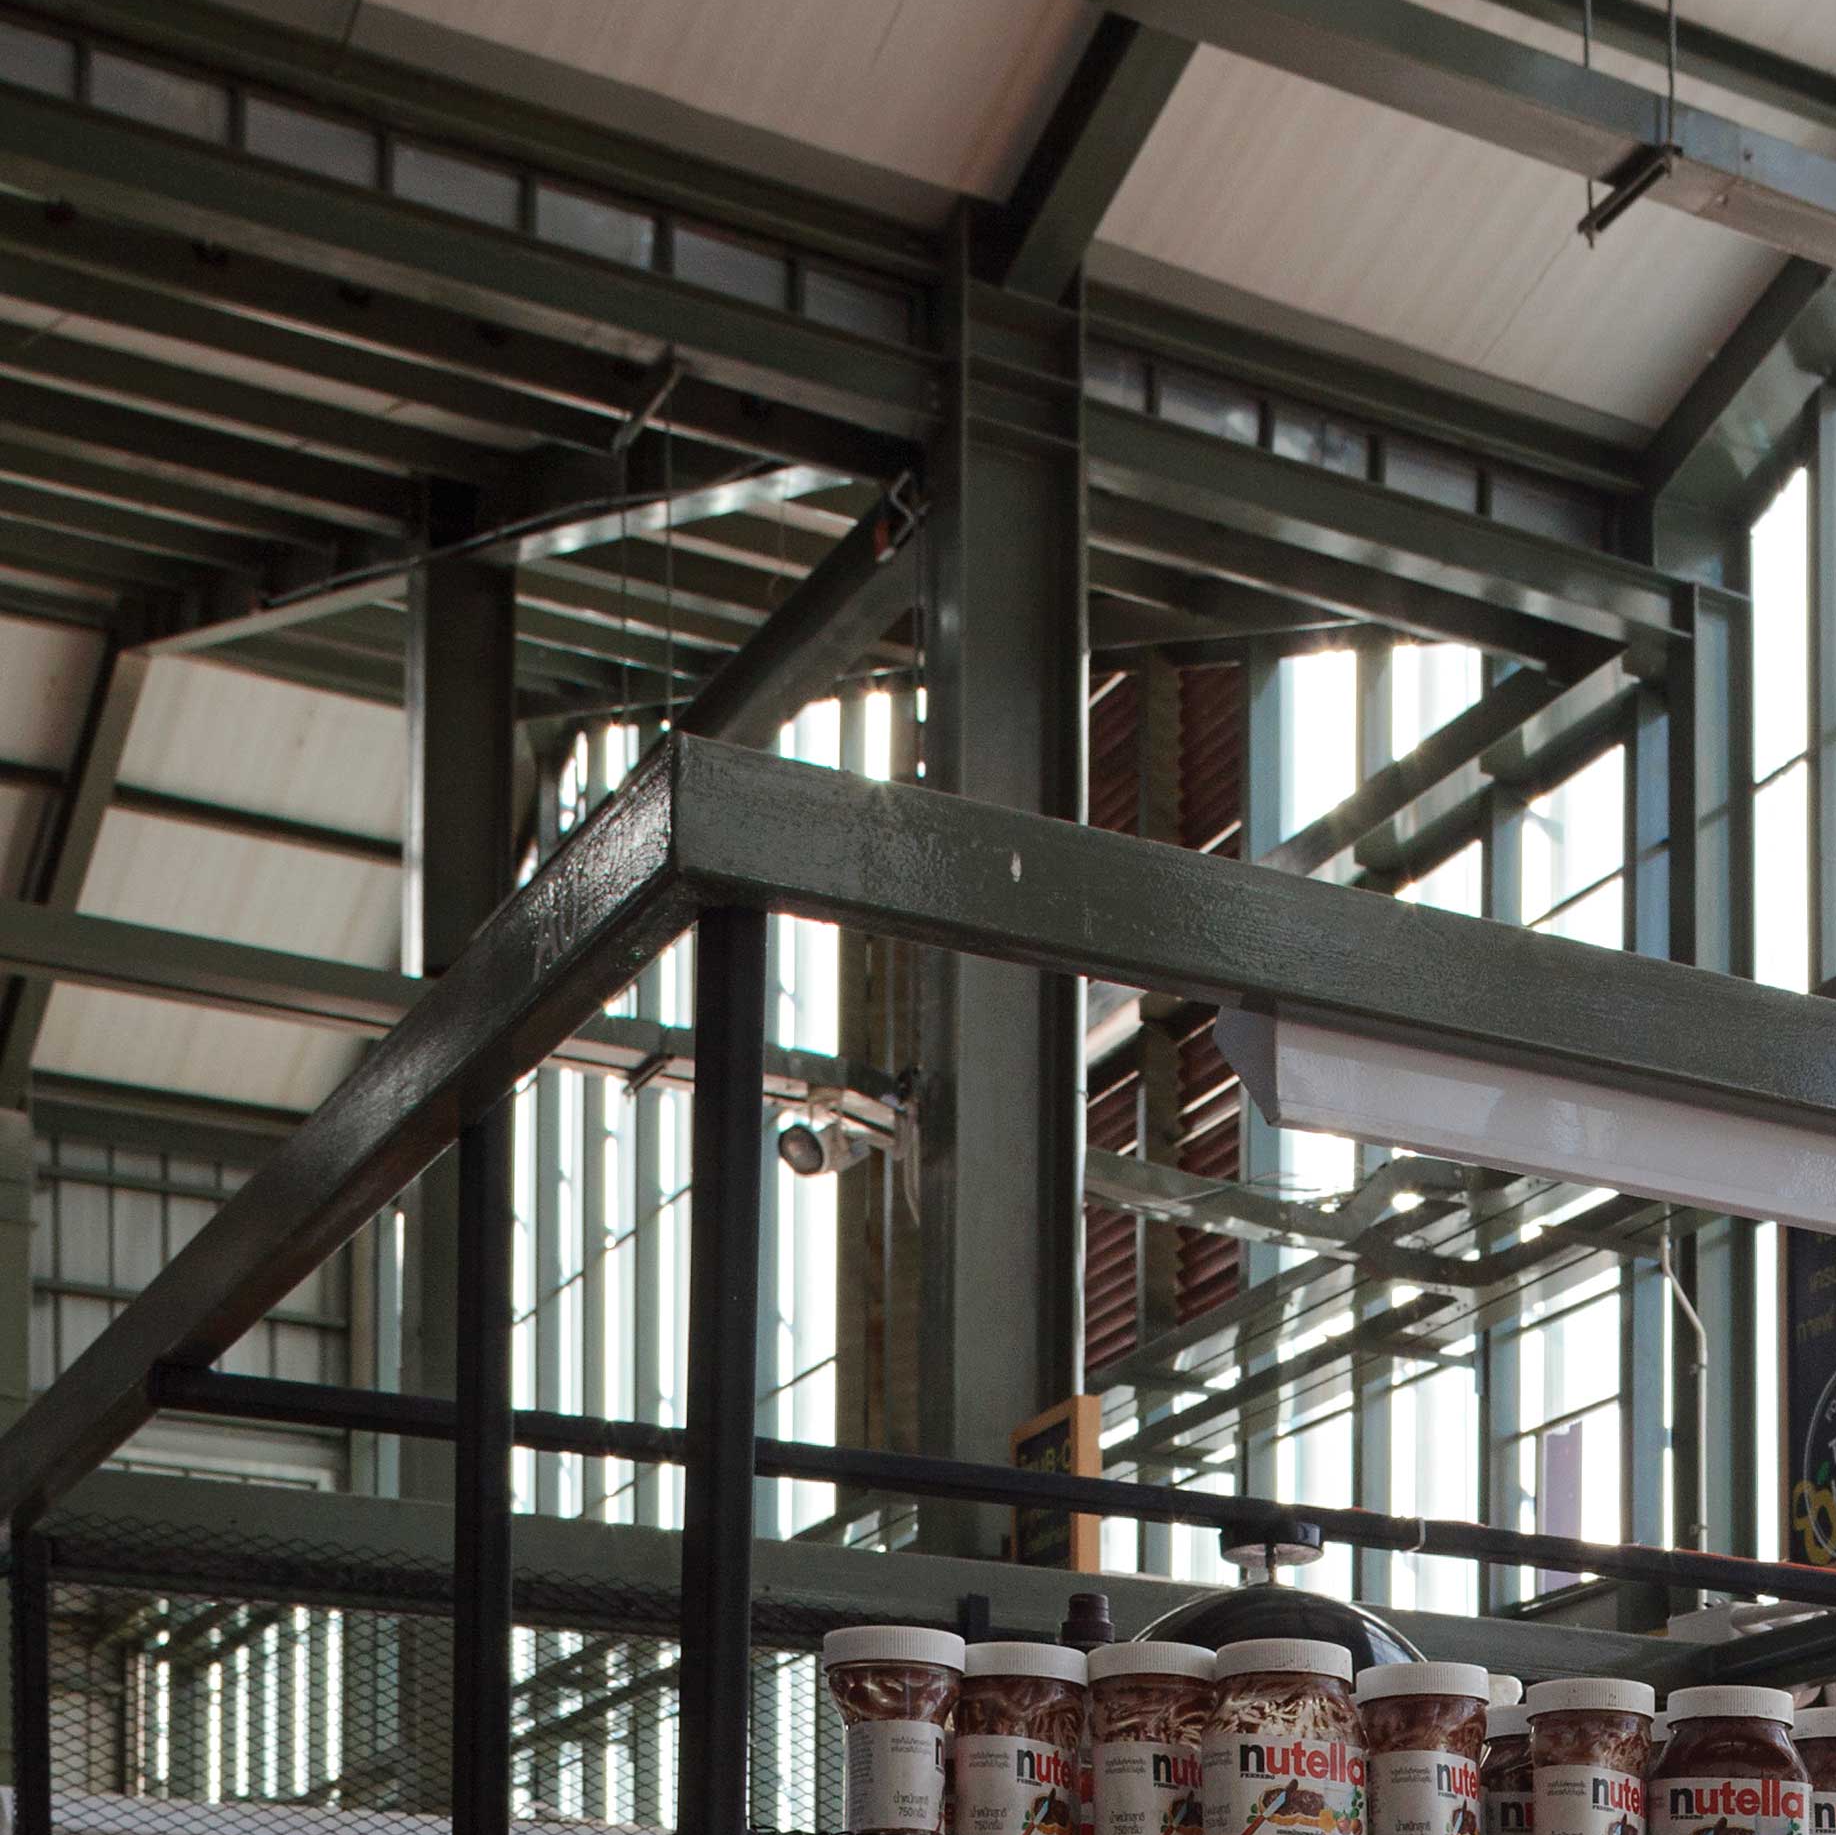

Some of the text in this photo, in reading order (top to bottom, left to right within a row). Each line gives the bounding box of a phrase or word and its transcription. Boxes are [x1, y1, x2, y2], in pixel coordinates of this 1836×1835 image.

[1016, 1747, 1075, 1788] nute
[1240, 1741, 1366, 1786] nutella
[1436, 1763, 1479, 1800] nute
[1592, 1777, 1646, 1820] nutel
[1670, 1780, 1804, 1818] nutella
